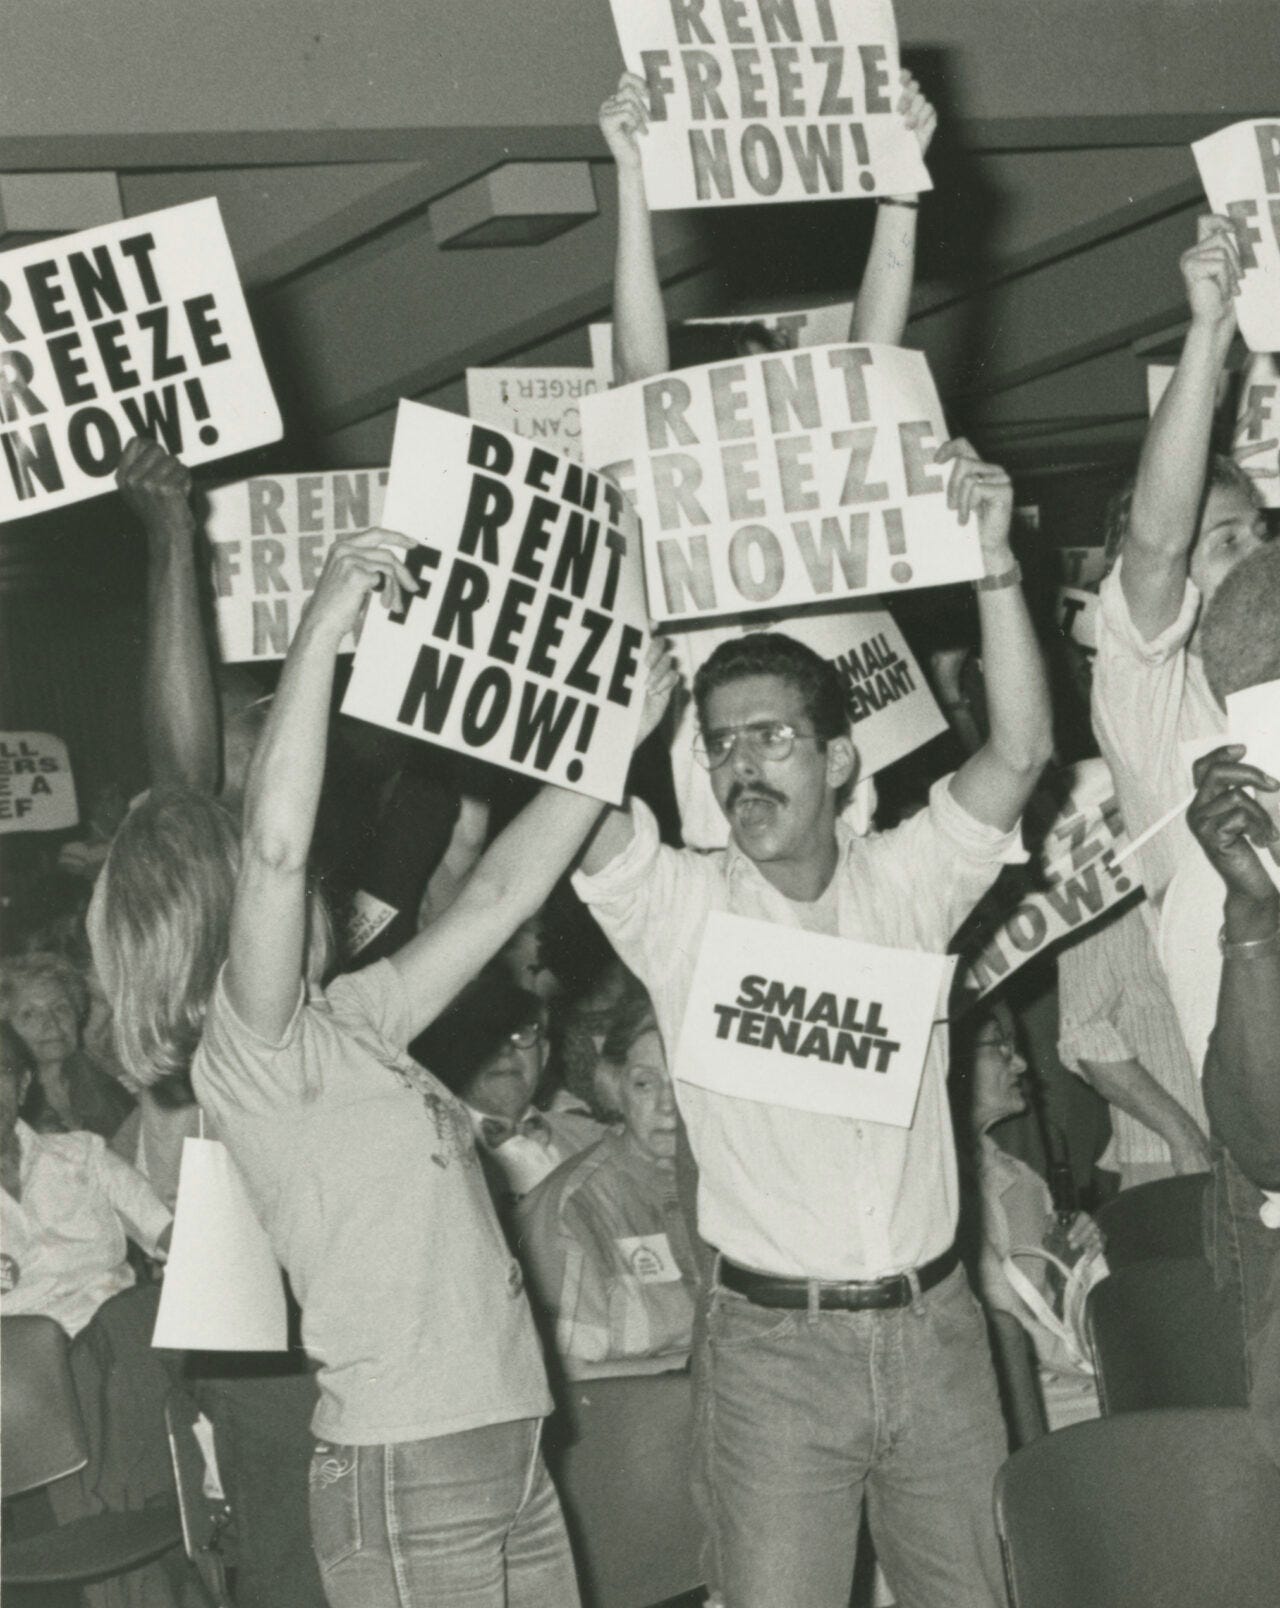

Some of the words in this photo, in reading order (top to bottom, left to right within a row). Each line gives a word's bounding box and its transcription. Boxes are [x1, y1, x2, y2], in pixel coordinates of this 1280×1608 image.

[670, 0, 838, 44] RENT
[639, 45, 892, 122] FREEZE
[688, 123, 876, 200] NOW!
[0, 293, 232, 424] REEZE
[499, 379, 599, 403] URGER!
[642, 347, 873, 450] RENT
[0, 377, 219, 501] NOW!
[247, 472, 389, 537] REN
[458, 472, 627, 611] RENT
[214, 533, 325, 598] FRE
[656, 508, 913, 616] NOW!
[387, 544, 643, 708] FREEZE
[834, 633, 899, 684] MALL
[396, 644, 600, 783] NOW!
[849, 660, 917, 725] ENANT
[969, 848, 1131, 991] NOW!
[714, 1003, 901, 1074] TENANT
[736, 974, 888, 1038] SMALL
